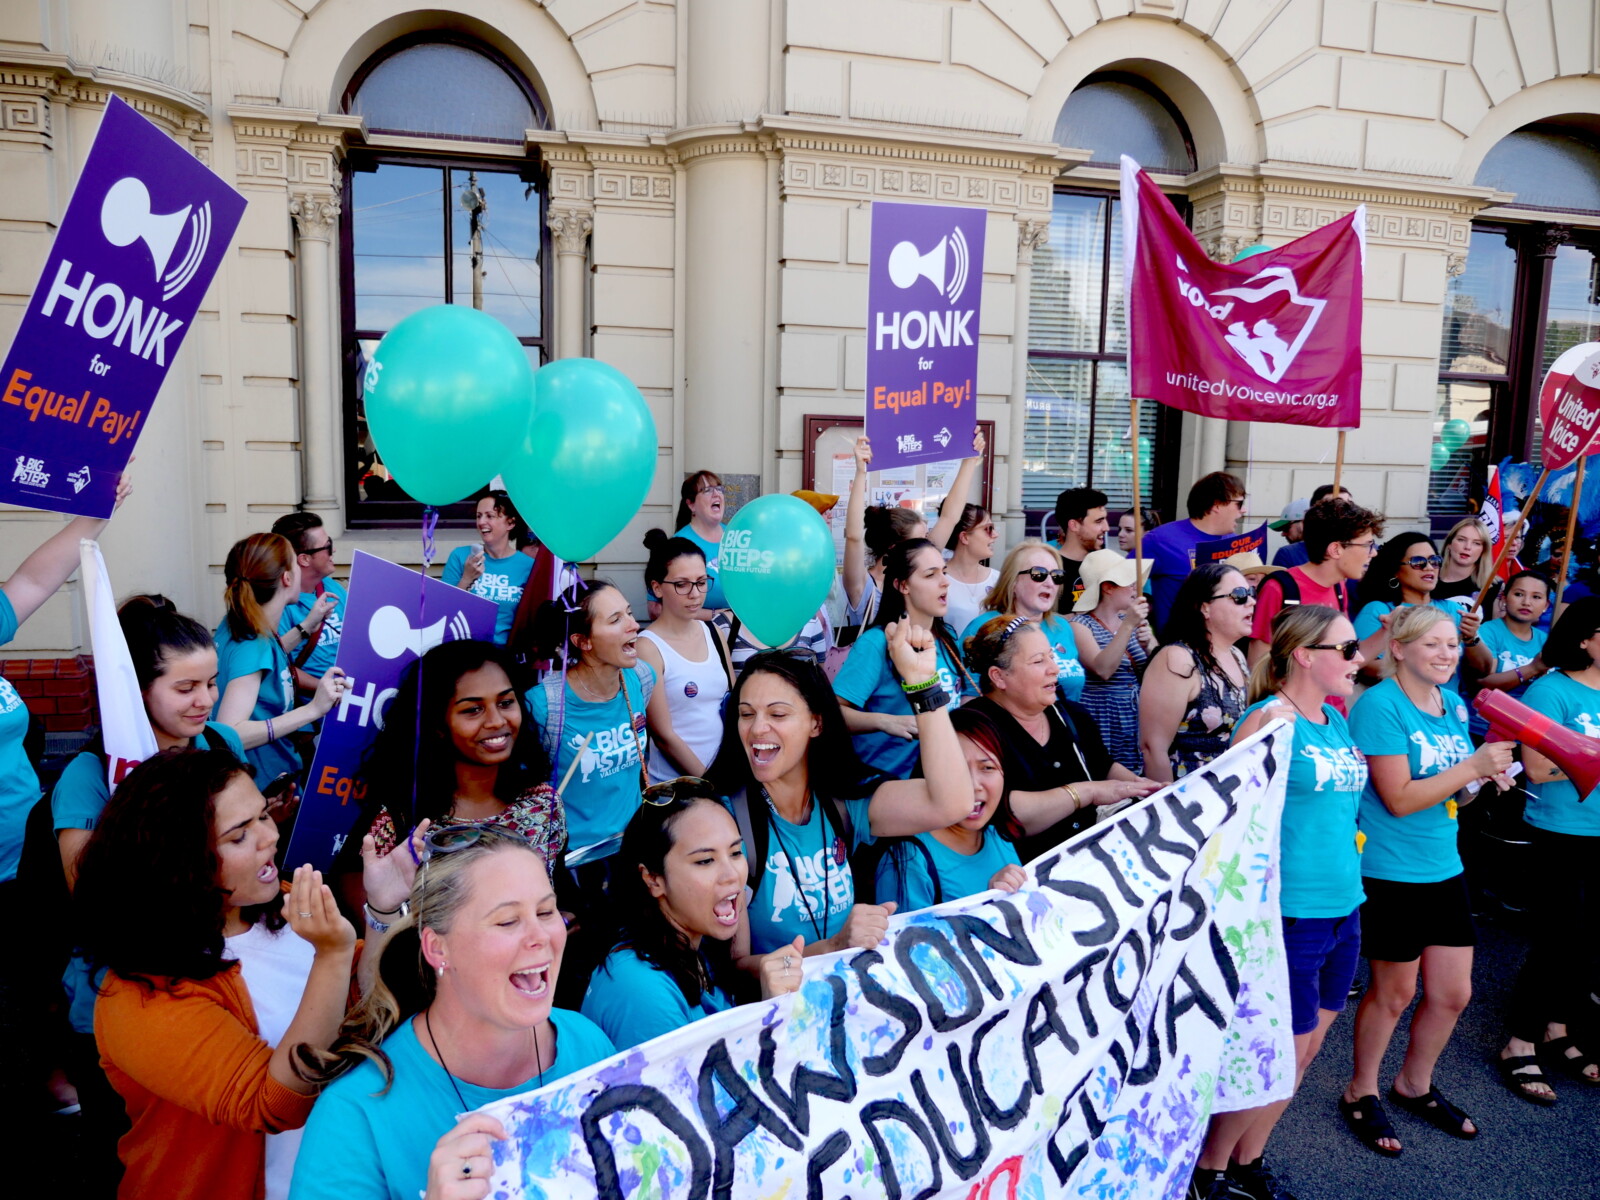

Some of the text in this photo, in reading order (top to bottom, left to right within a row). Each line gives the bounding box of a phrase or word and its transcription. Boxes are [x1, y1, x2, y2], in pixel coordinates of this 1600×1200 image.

[41, 258, 184, 367] HONK
[875, 310, 975, 350] HONK
[89, 353, 111, 376] for
[918, 356, 934, 371] for
[2, 368, 141, 444] Equal Pay!
[874, 379, 971, 415] Equal Pay!
[1557, 391, 1600, 431] United
[1549, 417, 1579, 453] Voice
[26, 457, 45, 472] BIG
[20, 469, 51, 485] STEPS
[725, 529, 752, 548] BIG
[1231, 536, 1252, 548] OUR
[721, 548, 777, 568] STEPS
[482, 573, 509, 587] BIG
[595, 722, 636, 753] BIG
[1433, 734, 1469, 754] BIG
[601, 768, 620, 779] VALUE
[830, 898, 848, 914] OUR
[580, 898, 1042, 1200] DAWSON
[806, 884, 1207, 1200] EDUCATORS
